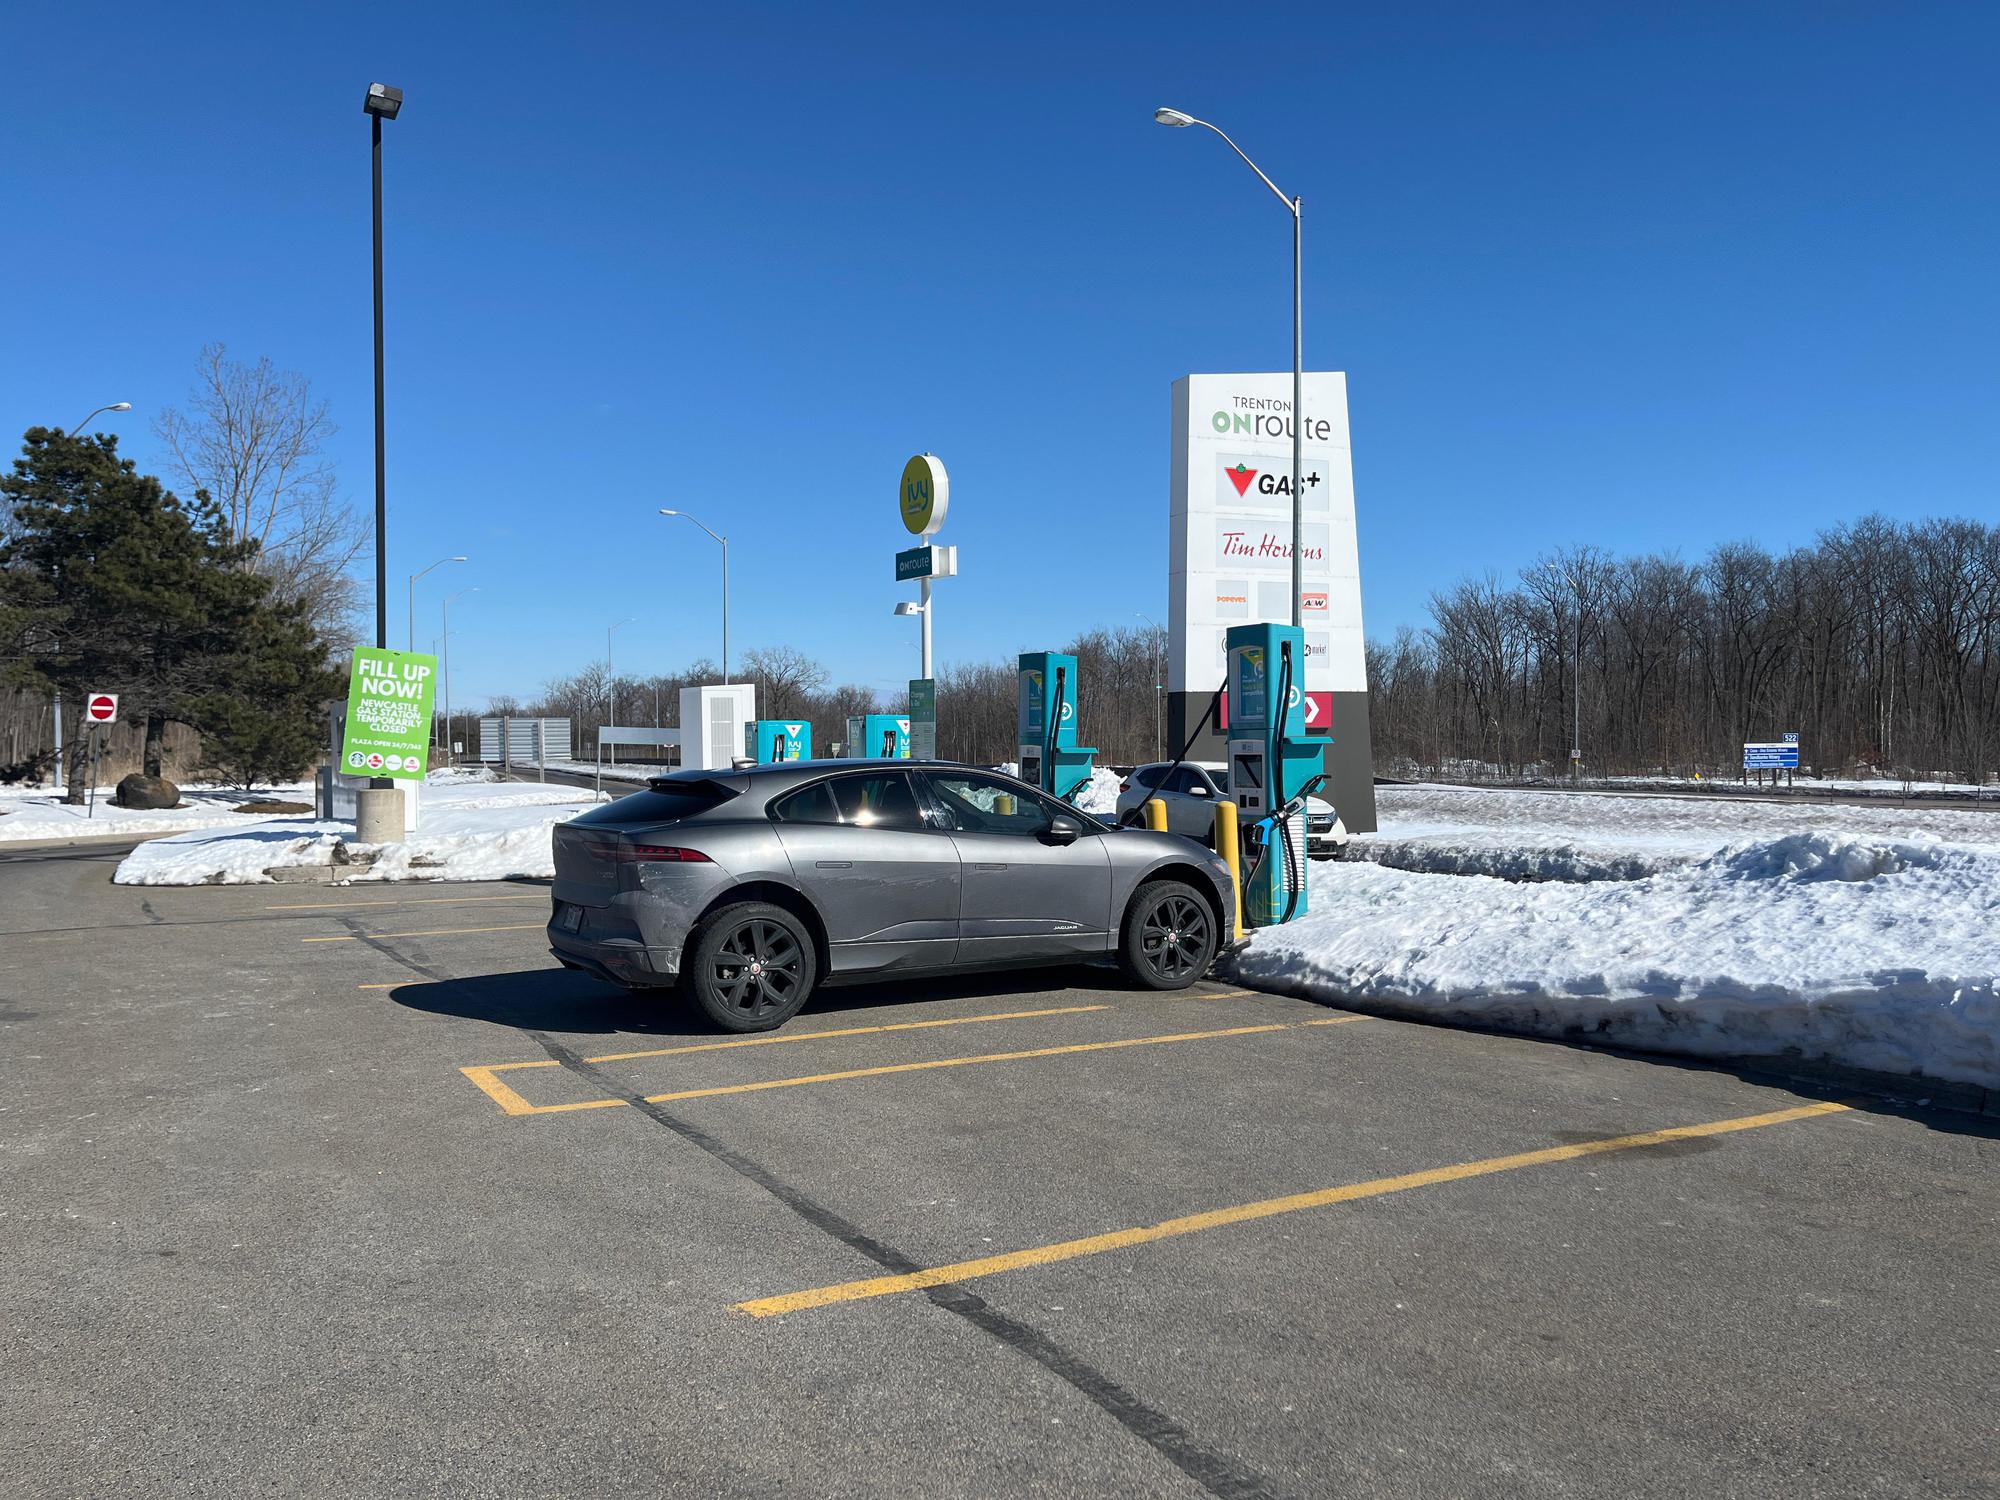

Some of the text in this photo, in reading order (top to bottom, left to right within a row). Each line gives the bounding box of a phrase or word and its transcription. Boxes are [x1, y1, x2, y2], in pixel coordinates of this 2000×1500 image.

[1233, 396, 1292, 412] TRENTON
[907, 477, 928, 512] ivy
[1223, 532, 1322, 560] Tim Hortns
[359, 659, 431, 682] FILL UP
[361, 677, 424, 700] NOW!
[361, 698, 419, 712] NEWCASTLE
[356, 706, 421, 720] GAS STATION
[356, 713, 423, 728] TEMPORARILY
[370, 723, 407, 734] CLOSED
[787, 738, 802, 751] ivy
[901, 736, 910, 746] iv
